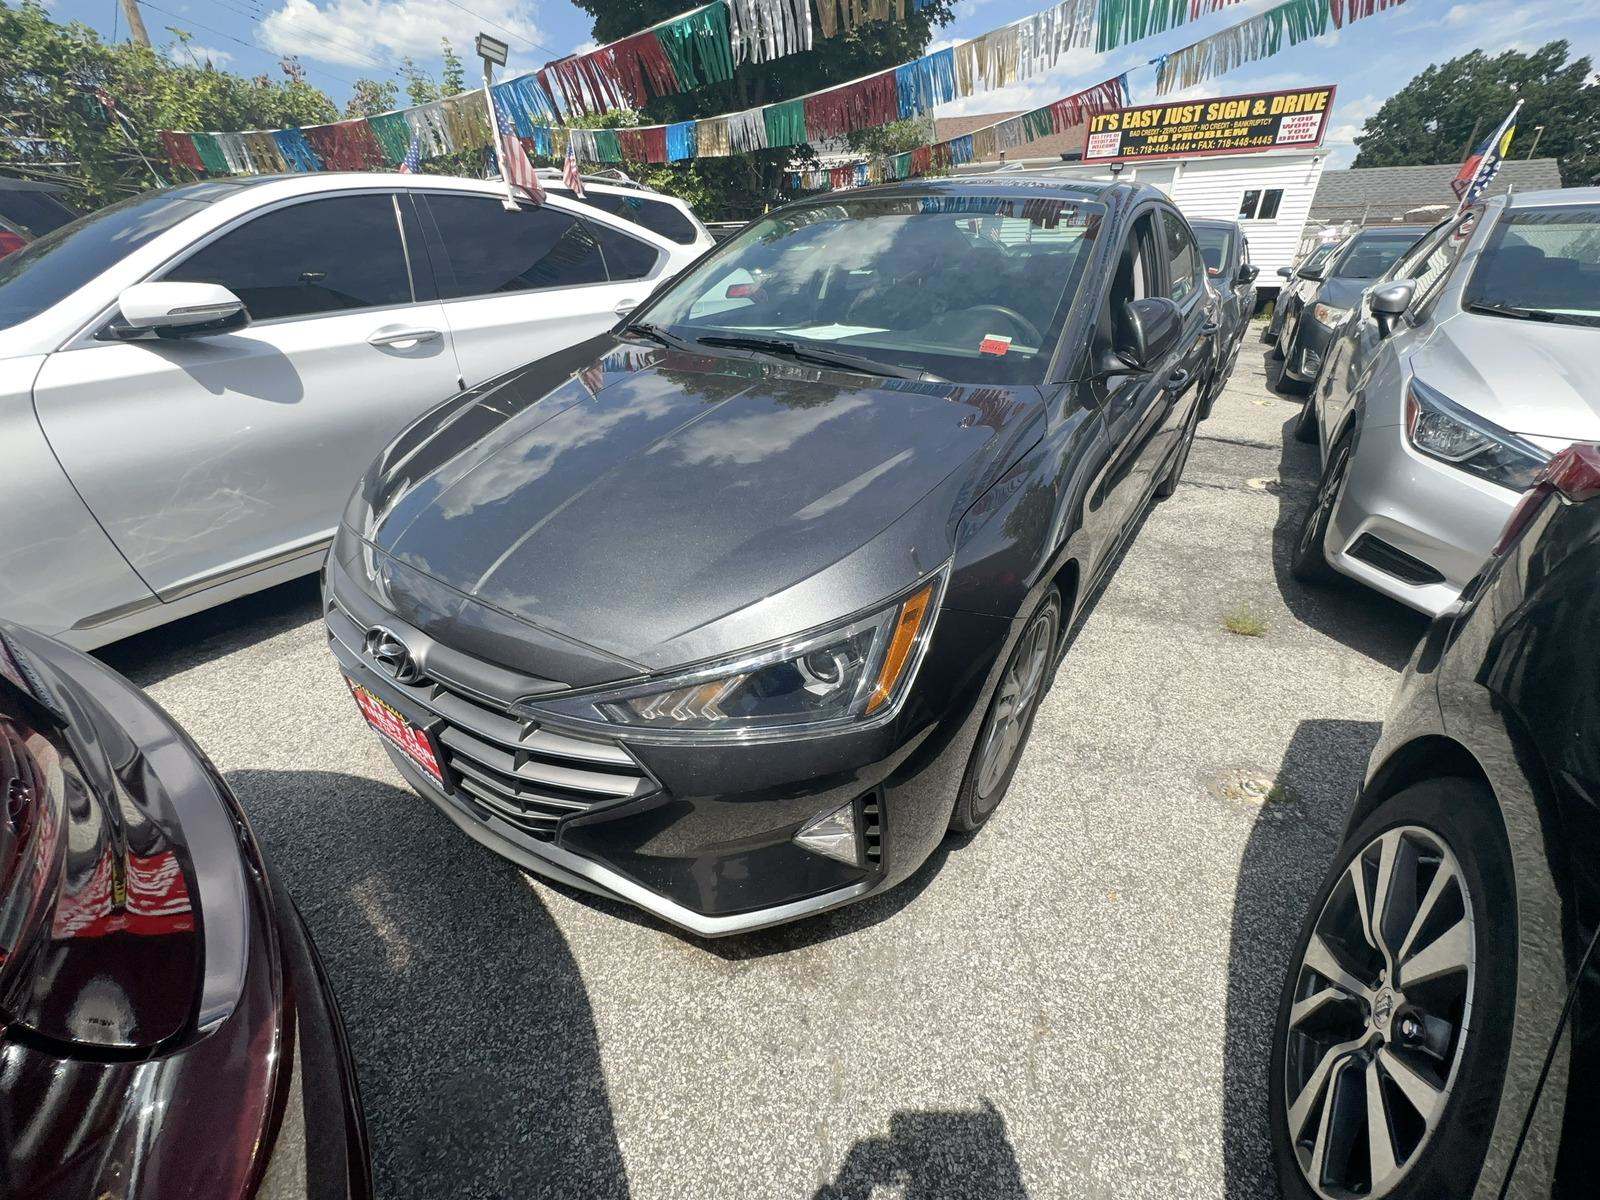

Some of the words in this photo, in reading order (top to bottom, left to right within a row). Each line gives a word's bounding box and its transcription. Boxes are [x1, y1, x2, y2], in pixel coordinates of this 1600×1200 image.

[1091, 113, 1119, 132] IT'S
[1122, 109, 1162, 129] EASY
[1162, 104, 1204, 125] JUST
[1207, 100, 1250, 121] SIGN
[1252, 99, 1266, 116] &
[1270, 91, 1329, 114] DRIVE
[1141, 128, 1159, 136] CREDIT
[1162, 126, 1177, 134] ZERO
[1178, 124, 1198, 133] CREDIT
[1200, 123, 1209, 131] NO
[1210, 121, 1230, 130] CREDIT
[1233, 118, 1272, 128] BANKRUPTCY
[1282, 121, 1317, 129] WORK
[1147, 135, 1169, 144] NO
[1172, 127, 1248, 141] PROBLEM
[1123, 146, 1138, 155] TEL:
[1197, 140, 1216, 149] FAX:
